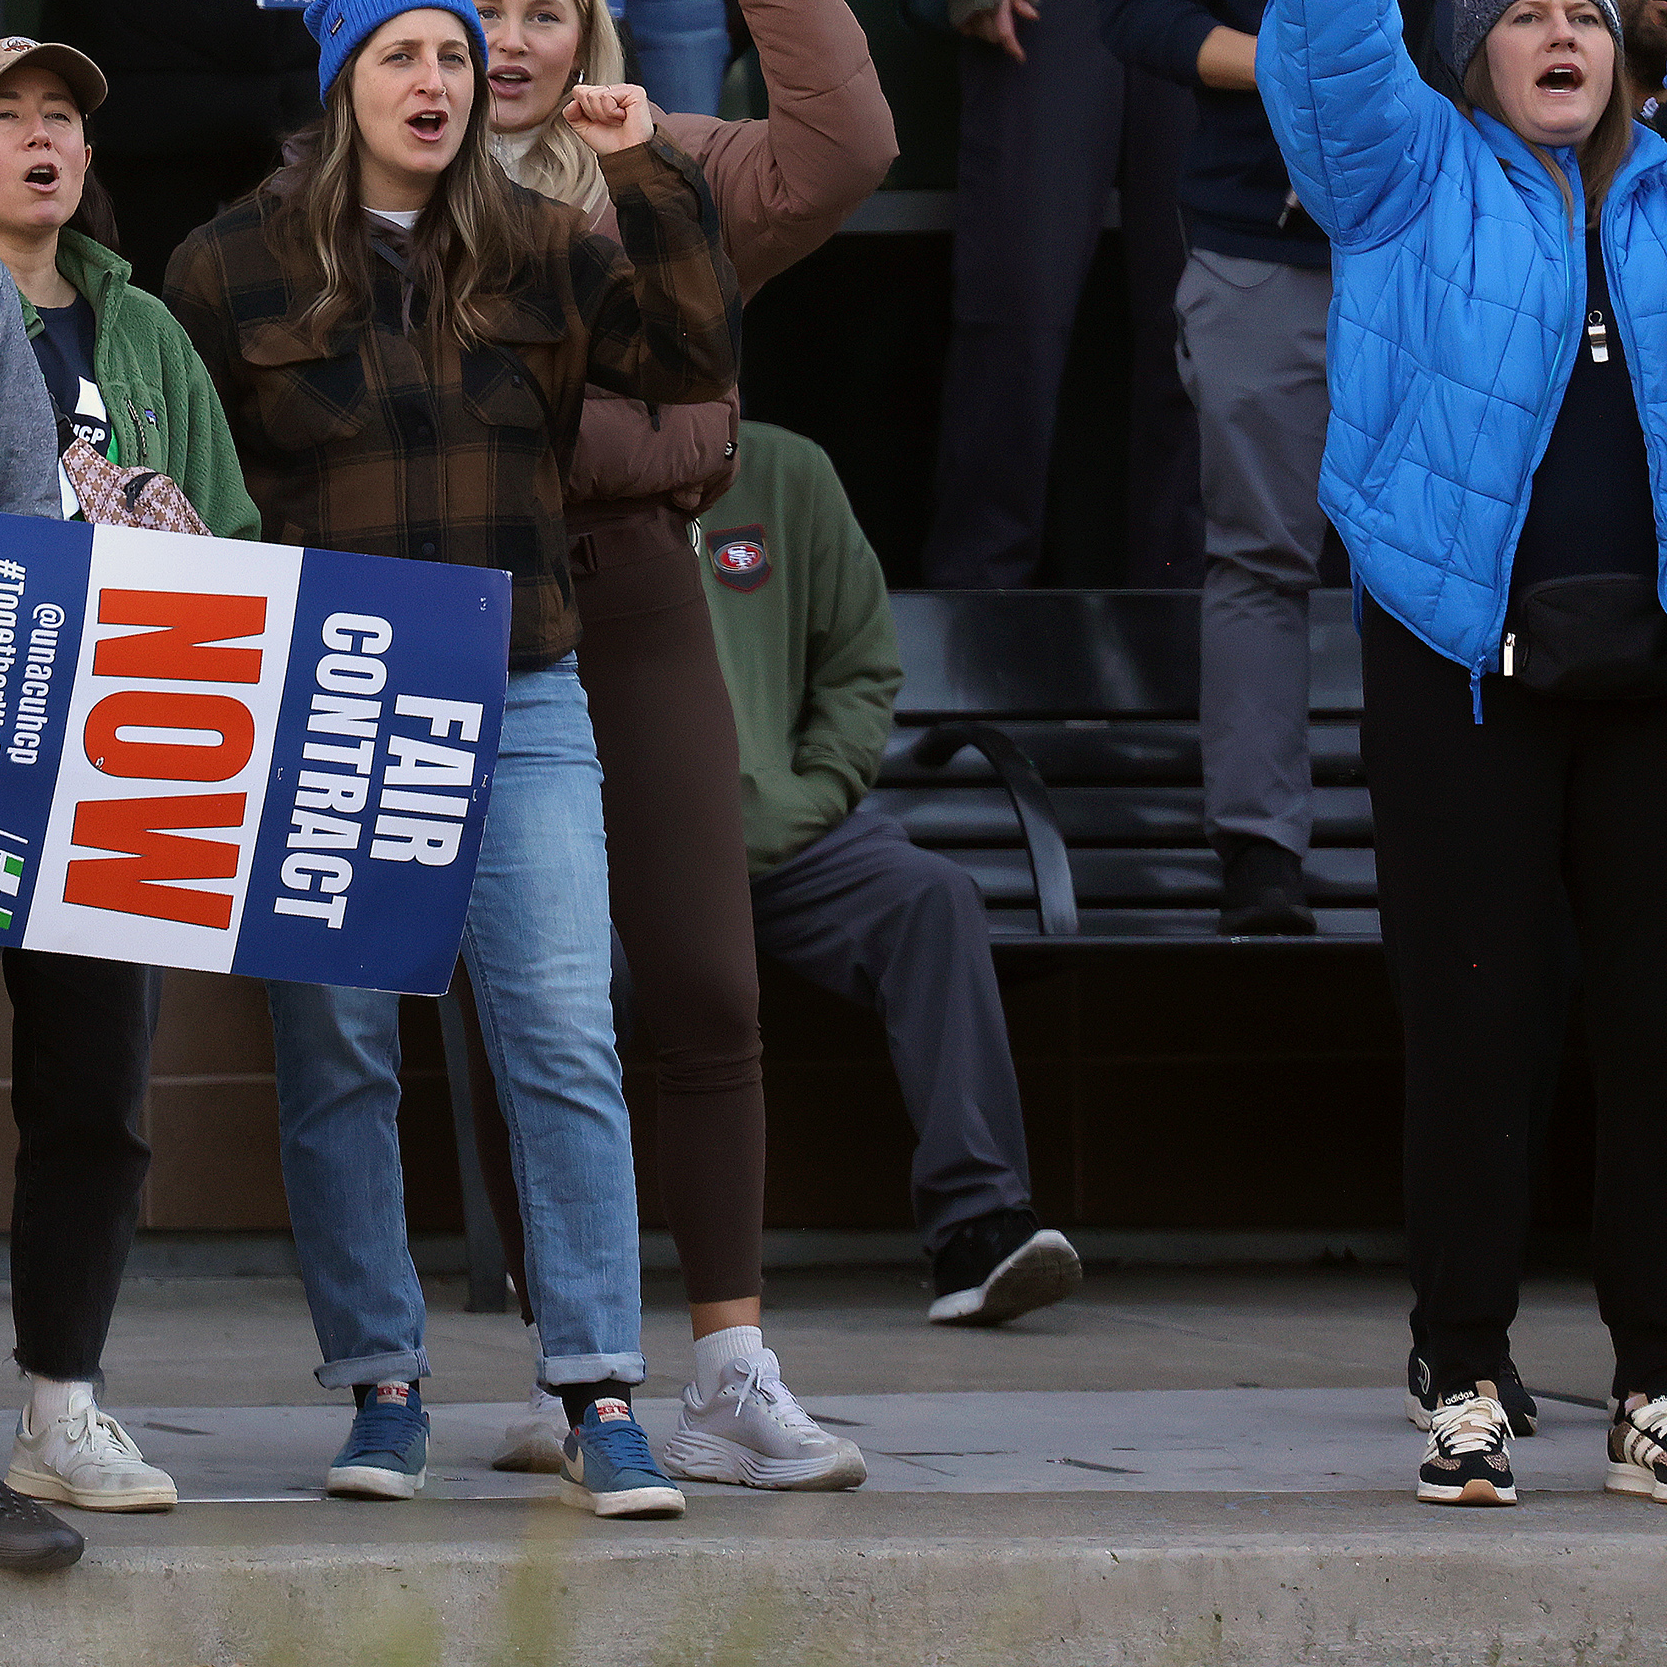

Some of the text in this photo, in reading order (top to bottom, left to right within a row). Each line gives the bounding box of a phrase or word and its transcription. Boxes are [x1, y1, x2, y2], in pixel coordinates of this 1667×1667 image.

[7, 603, 65, 766] @unacuhcp
[62, 588, 268, 931] NOW
[274, 611, 392, 930] CONTRACT
[370, 693, 484, 868] FAIR
[1445, 1390, 1475, 1405] adidas
